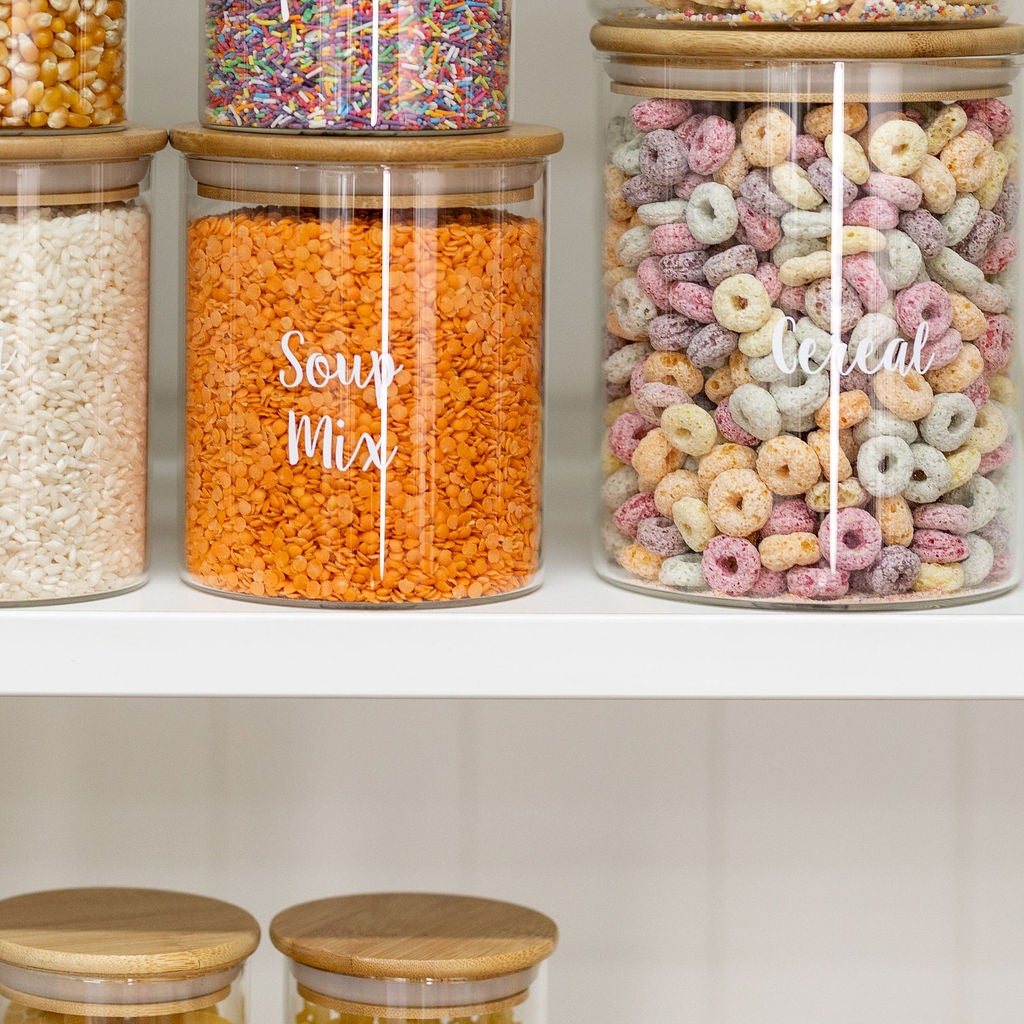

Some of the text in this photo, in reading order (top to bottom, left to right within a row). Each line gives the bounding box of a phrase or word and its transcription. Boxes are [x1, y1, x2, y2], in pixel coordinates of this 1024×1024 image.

[278, 328, 404, 410] Soup
[771, 318, 937, 378] Cereal
[286, 409, 398, 472] Mix
